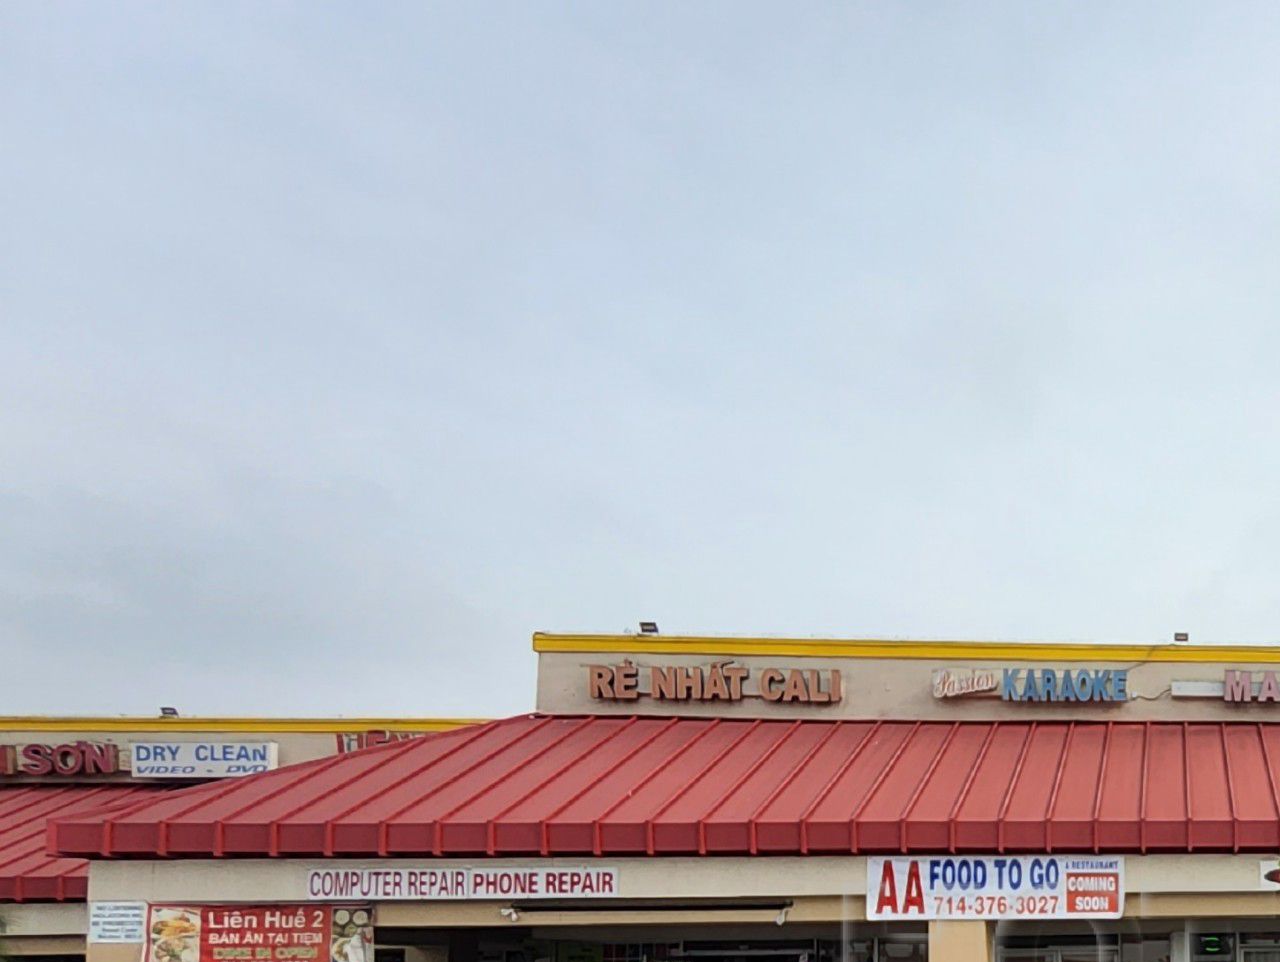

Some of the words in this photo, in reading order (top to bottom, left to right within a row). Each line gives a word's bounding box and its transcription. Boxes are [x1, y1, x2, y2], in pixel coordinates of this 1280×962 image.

[759, 667, 842, 702] CALI
[932, 669, 999, 698] Passion
[1002, 668, 1128, 702] KARAOKE
[135, 745, 180, 762] DRY
[194, 744, 267, 762] CLEAN
[136, 765, 196, 774] VIDEO
[225, 764, 268, 774] DVD
[309, 871, 402, 897] COMPUTER
[408, 871, 466, 897] REPAIR
[472, 872, 538, 895] PHONE
[545, 872, 614, 894] REPAIR
[875, 860, 926, 914] AA
[929, 858, 988, 891] FOOD
[994, 858, 1023, 891] TO
[1030, 858, 1060, 891] GO
[1067, 876, 1116, 891] COMING
[1075, 896, 1109, 911] SOON
[208, 911, 258, 929] Liên
[264, 907, 306, 929] Huế
[312, 911, 324, 928] 2
